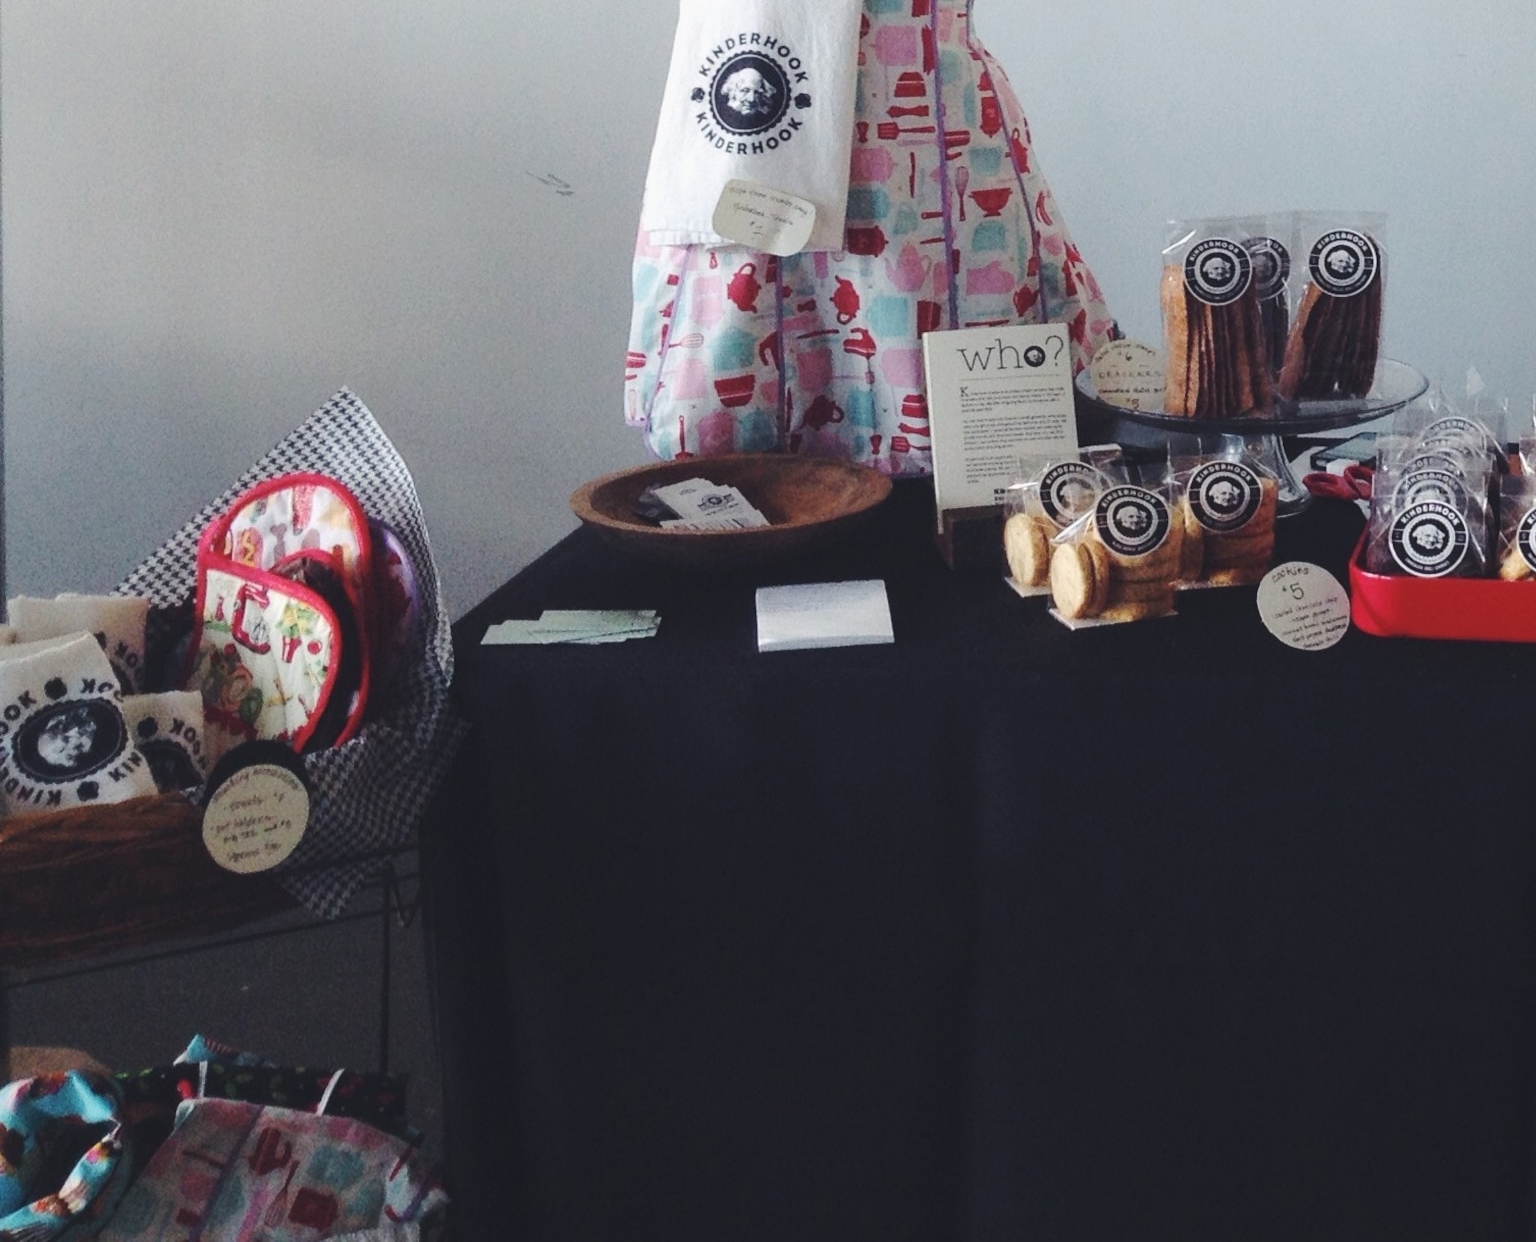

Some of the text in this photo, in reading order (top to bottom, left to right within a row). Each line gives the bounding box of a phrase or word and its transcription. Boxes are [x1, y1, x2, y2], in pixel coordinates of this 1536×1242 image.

[699, 32, 809, 83] KINDERHOOK
[695, 111, 804, 155] KINDERHOOK
[957, 335, 1065, 371] who?
[1196, 464, 1251, 483] KINDERHOOK
[1400, 504, 1460, 526] KINDERHOOK
[1272, 566, 1309, 583] cookies
